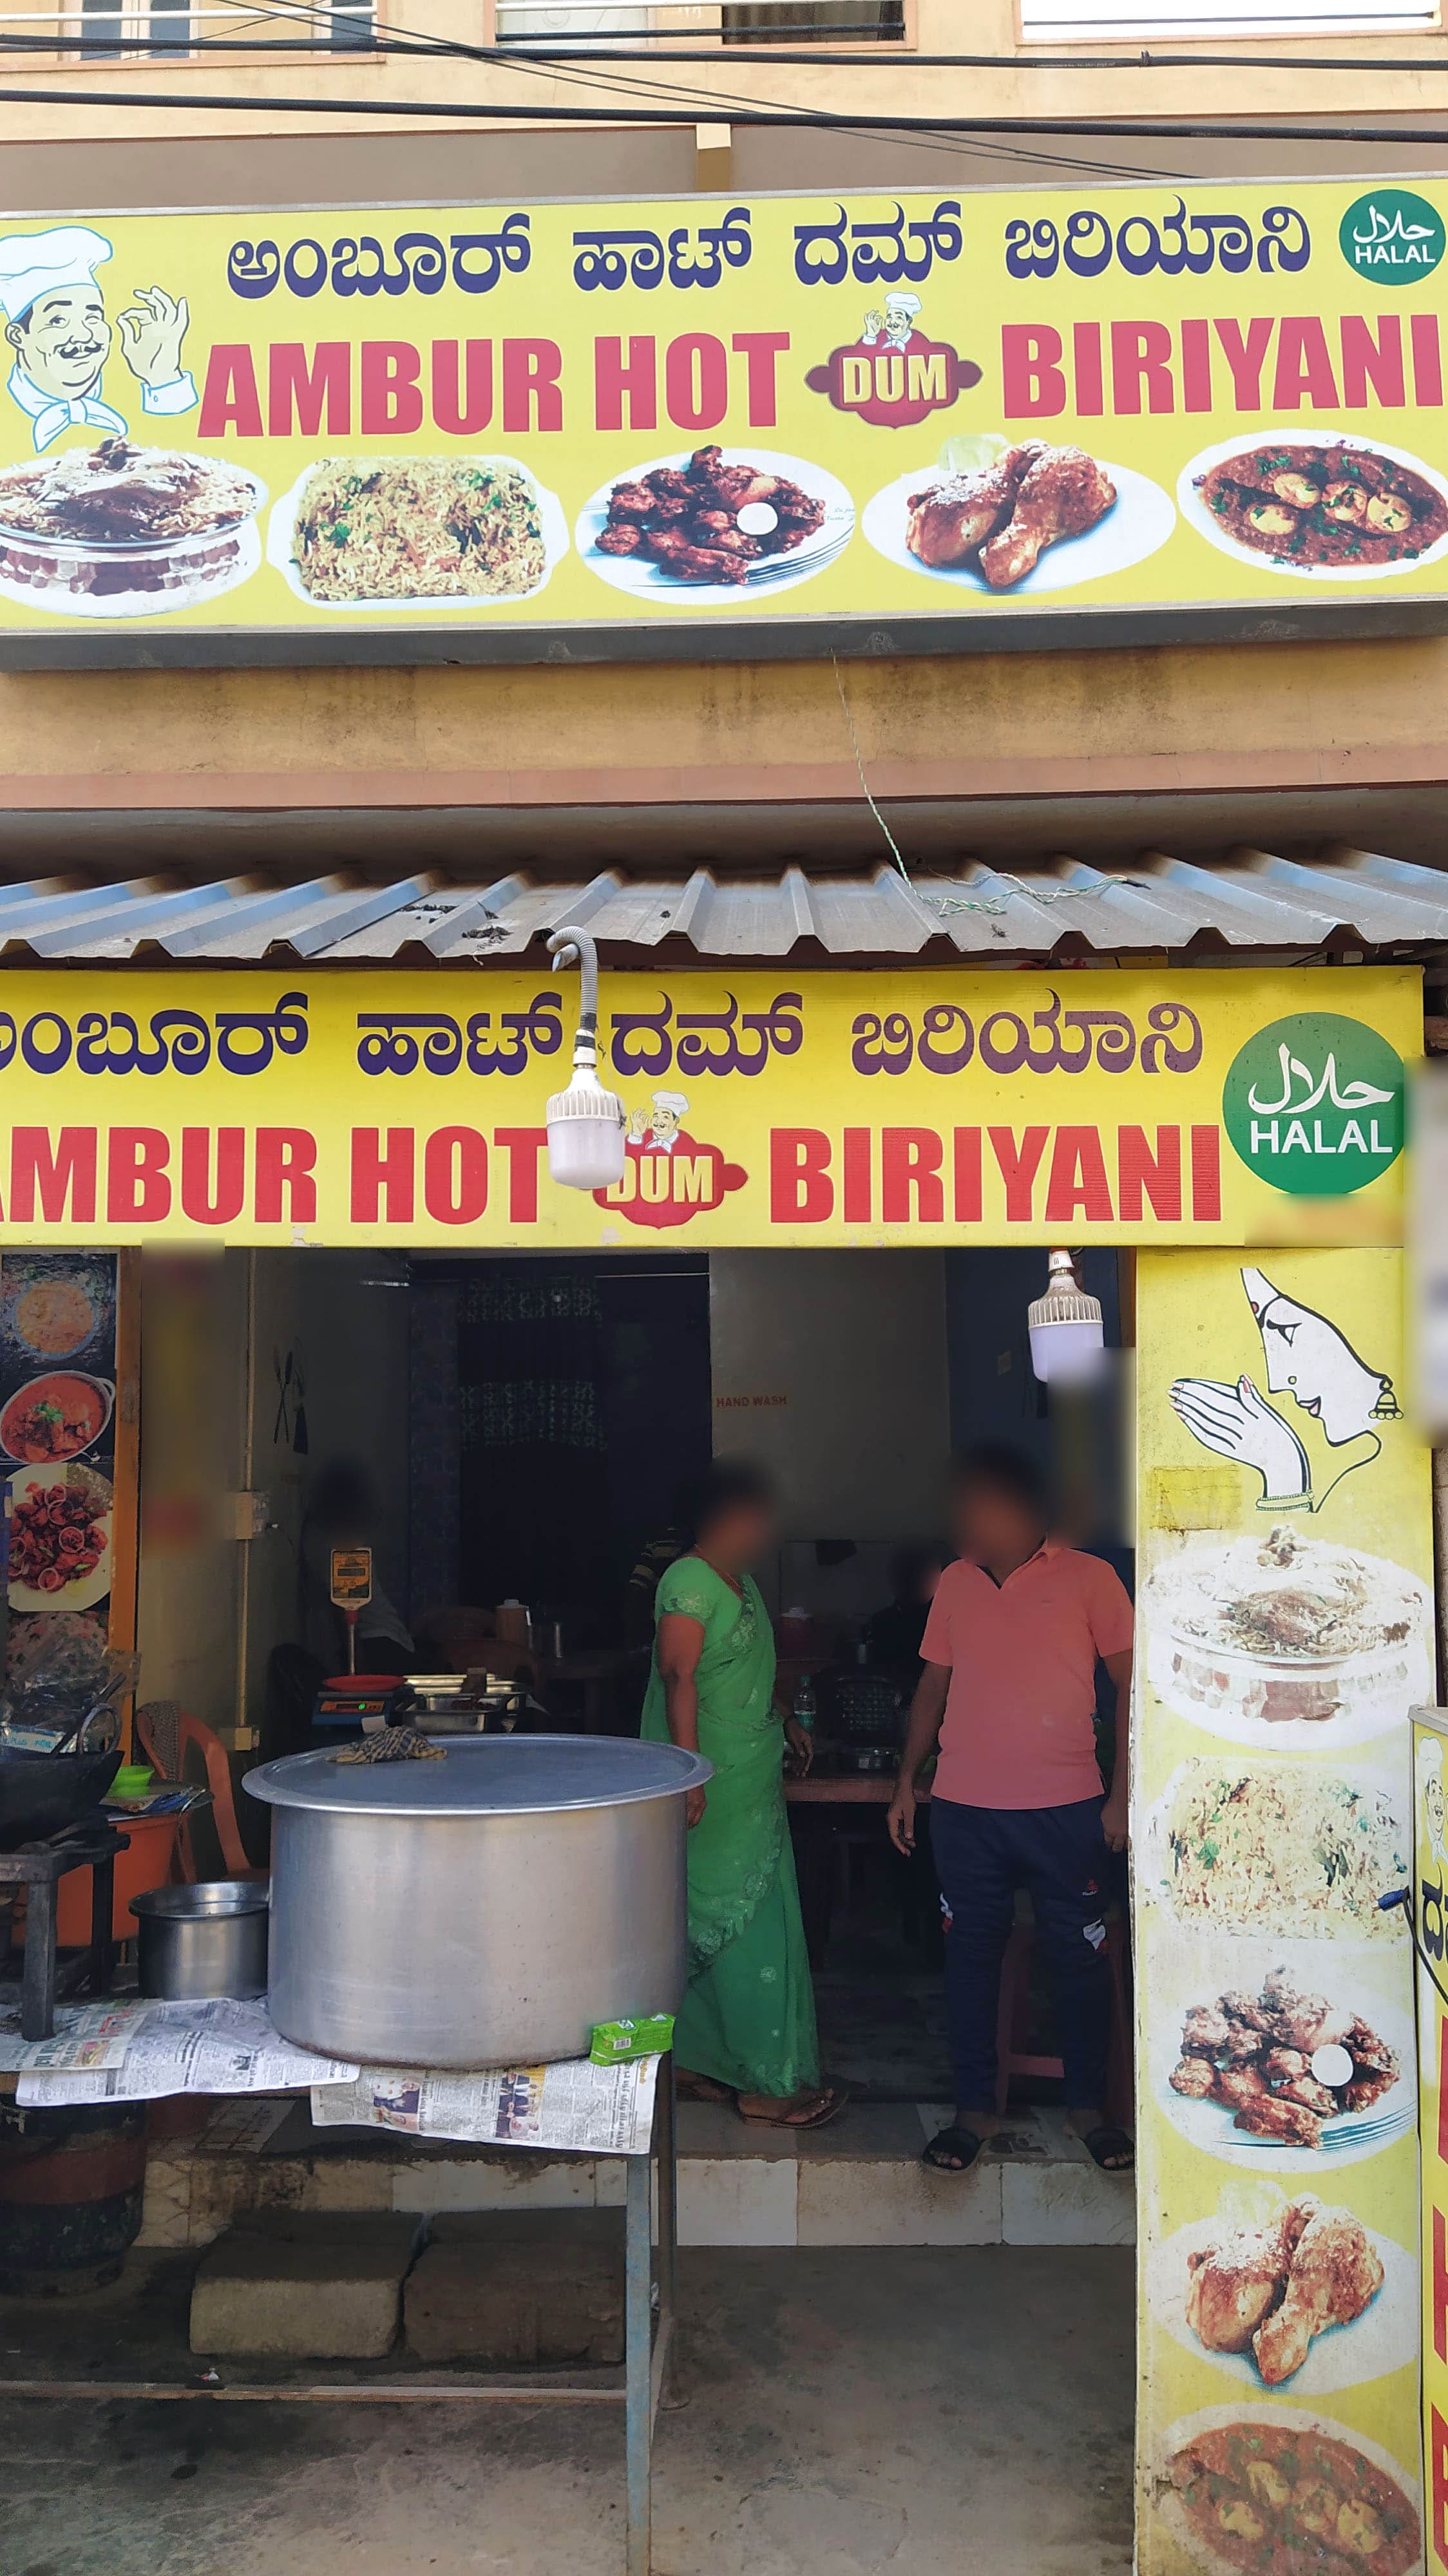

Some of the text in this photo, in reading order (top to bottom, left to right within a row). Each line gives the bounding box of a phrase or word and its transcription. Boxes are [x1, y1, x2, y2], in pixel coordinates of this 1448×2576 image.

[227, 194, 1311, 299] ಅಂಬೂರ್ ಹಾಟ್ ದಮ್ ಬಿರಿಯಾನಿ
[1353, 205, 1436, 243] حلال
[1355, 244, 1436, 265] HALAL
[198, 314, 1443, 439] AMBUR HOT DUM BIRIYANI
[357, 992, 563, 1076] ಹಾಟ್
[611, 990, 803, 1077] ದಮ್
[852, 989, 1203, 1075] ಬಿರಿಯಾನಿ
[1248, 1043, 1395, 1115] حلال
[1251, 1119, 1393, 1154] HALAL
[0, 1126, 317, 1224] MBUR
[350, 1125, 548, 1224] HOT
[770, 1125, 1222, 1223] BIRIYANI
[716, 1395, 787, 1408] HAND WASH
